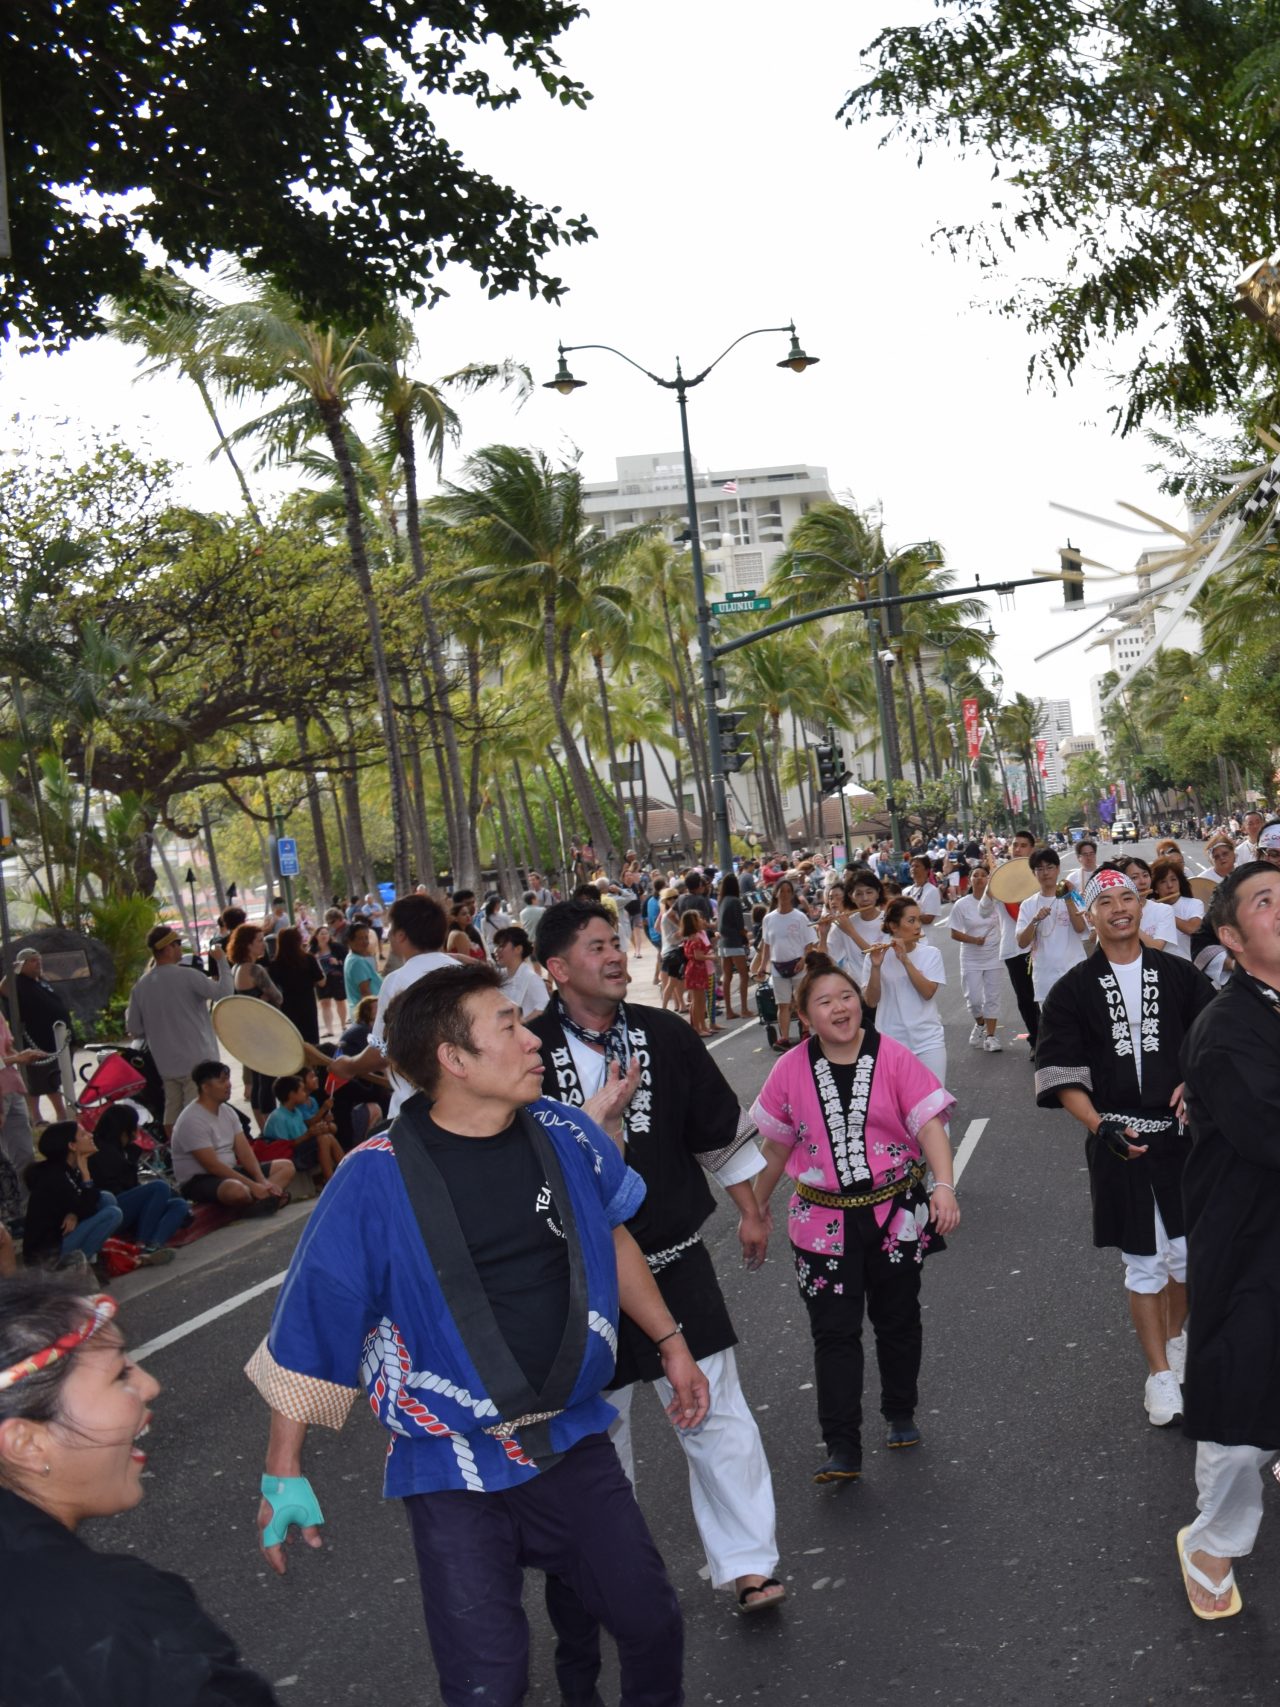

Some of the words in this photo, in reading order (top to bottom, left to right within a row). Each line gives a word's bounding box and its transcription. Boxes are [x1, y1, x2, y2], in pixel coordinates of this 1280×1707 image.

[718, 600, 755, 613] ULUNIU
[1098, 973, 1134, 1057] はわい教会
[1141, 968, 1161, 1053] はわい教会
